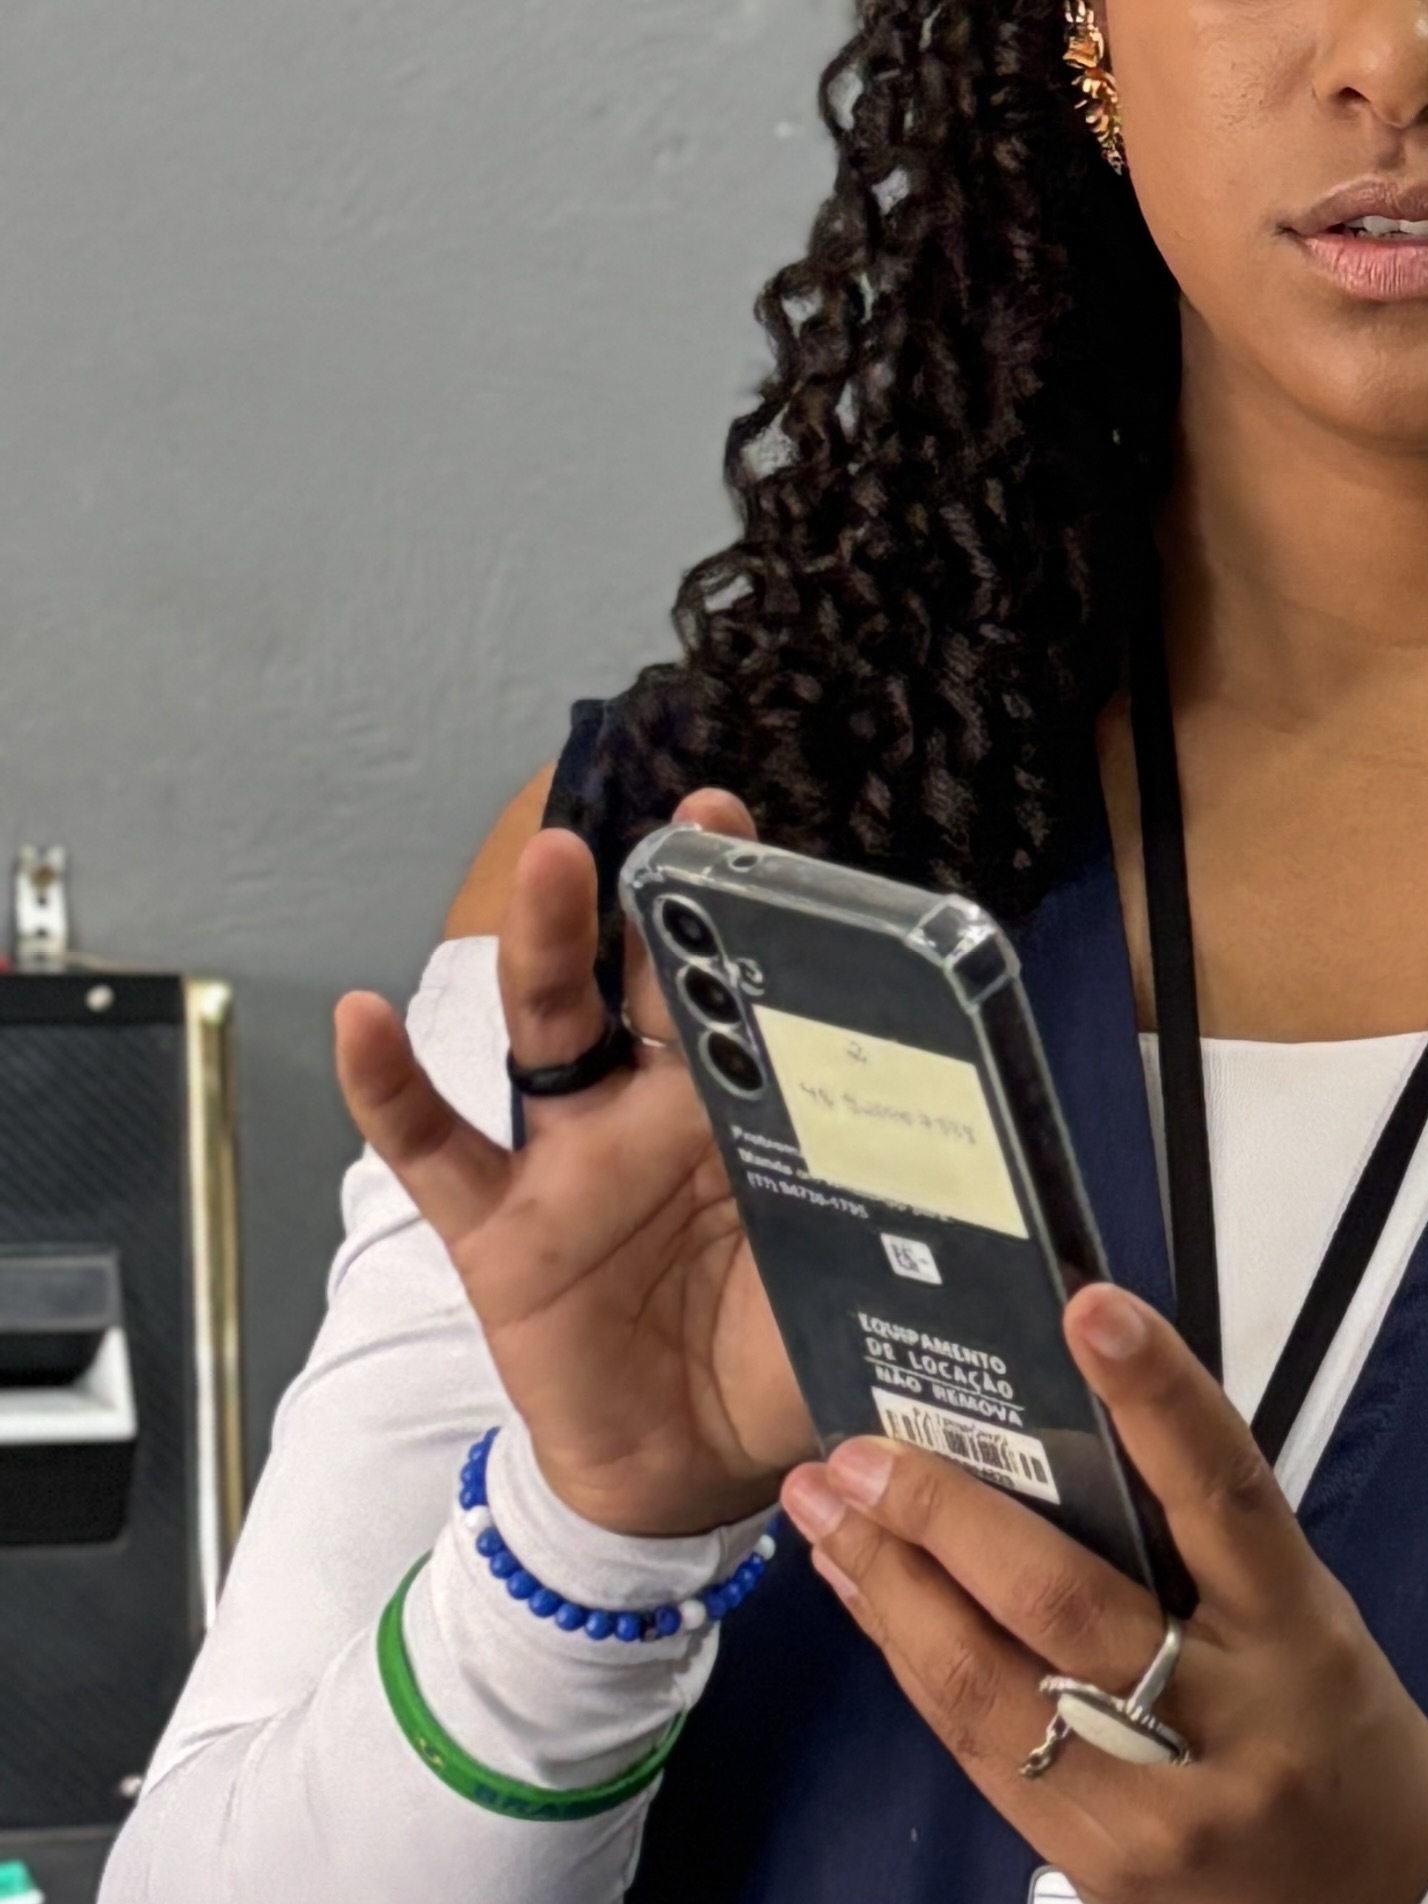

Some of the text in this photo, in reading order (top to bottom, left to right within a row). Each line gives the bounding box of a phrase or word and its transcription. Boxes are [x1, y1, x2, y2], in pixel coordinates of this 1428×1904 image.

[858, 1312, 1006, 1374] EQUIPAMENTO
[866, 1337, 1013, 1399] DE LOCAÇÃO
[875, 1366, 1023, 1427] NÃO REMOVA
